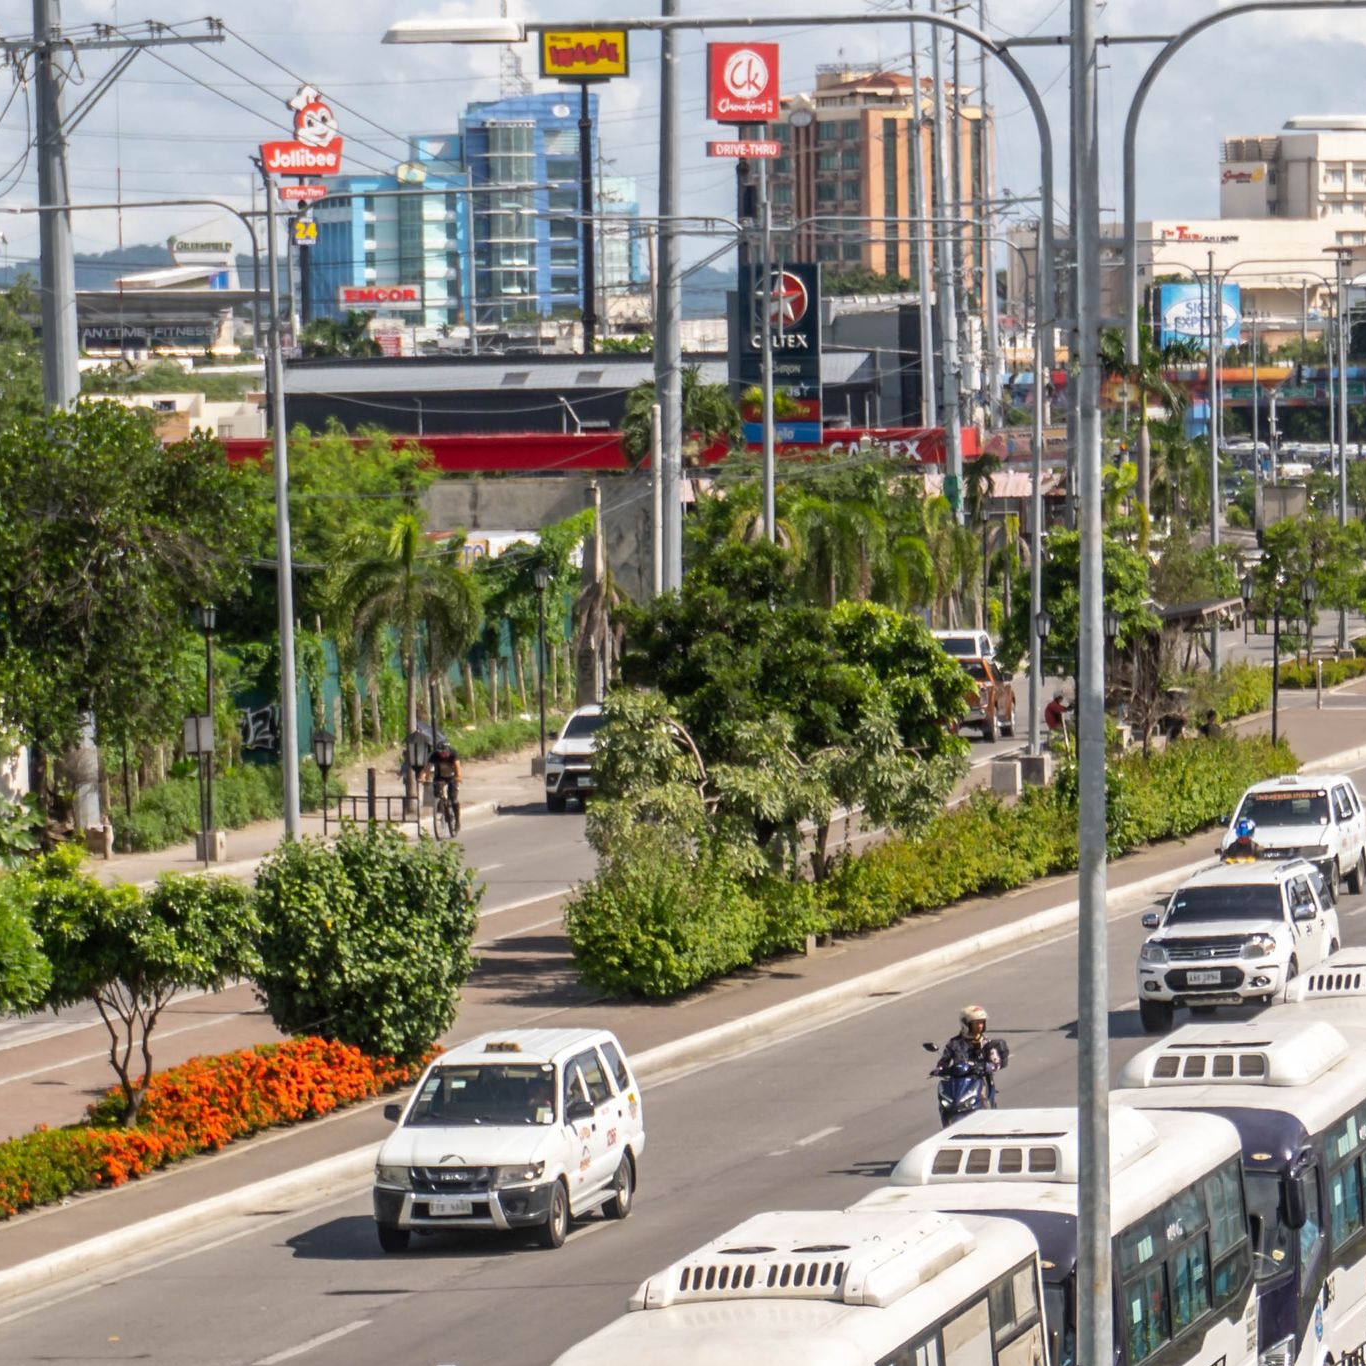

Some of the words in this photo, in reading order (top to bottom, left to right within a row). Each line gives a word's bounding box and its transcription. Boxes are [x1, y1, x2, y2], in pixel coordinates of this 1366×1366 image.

[716, 143, 777, 156] DRIVE-THRU
[269, 149, 337, 168] Jollibee
[295, 222, 317, 239] 24
[344, 288, 416, 303] EMCOR
[84, 327, 146, 338] ANYTIME
[154, 326, 215, 338] FITNESS
[751, 334, 808, 349] CLTEX
